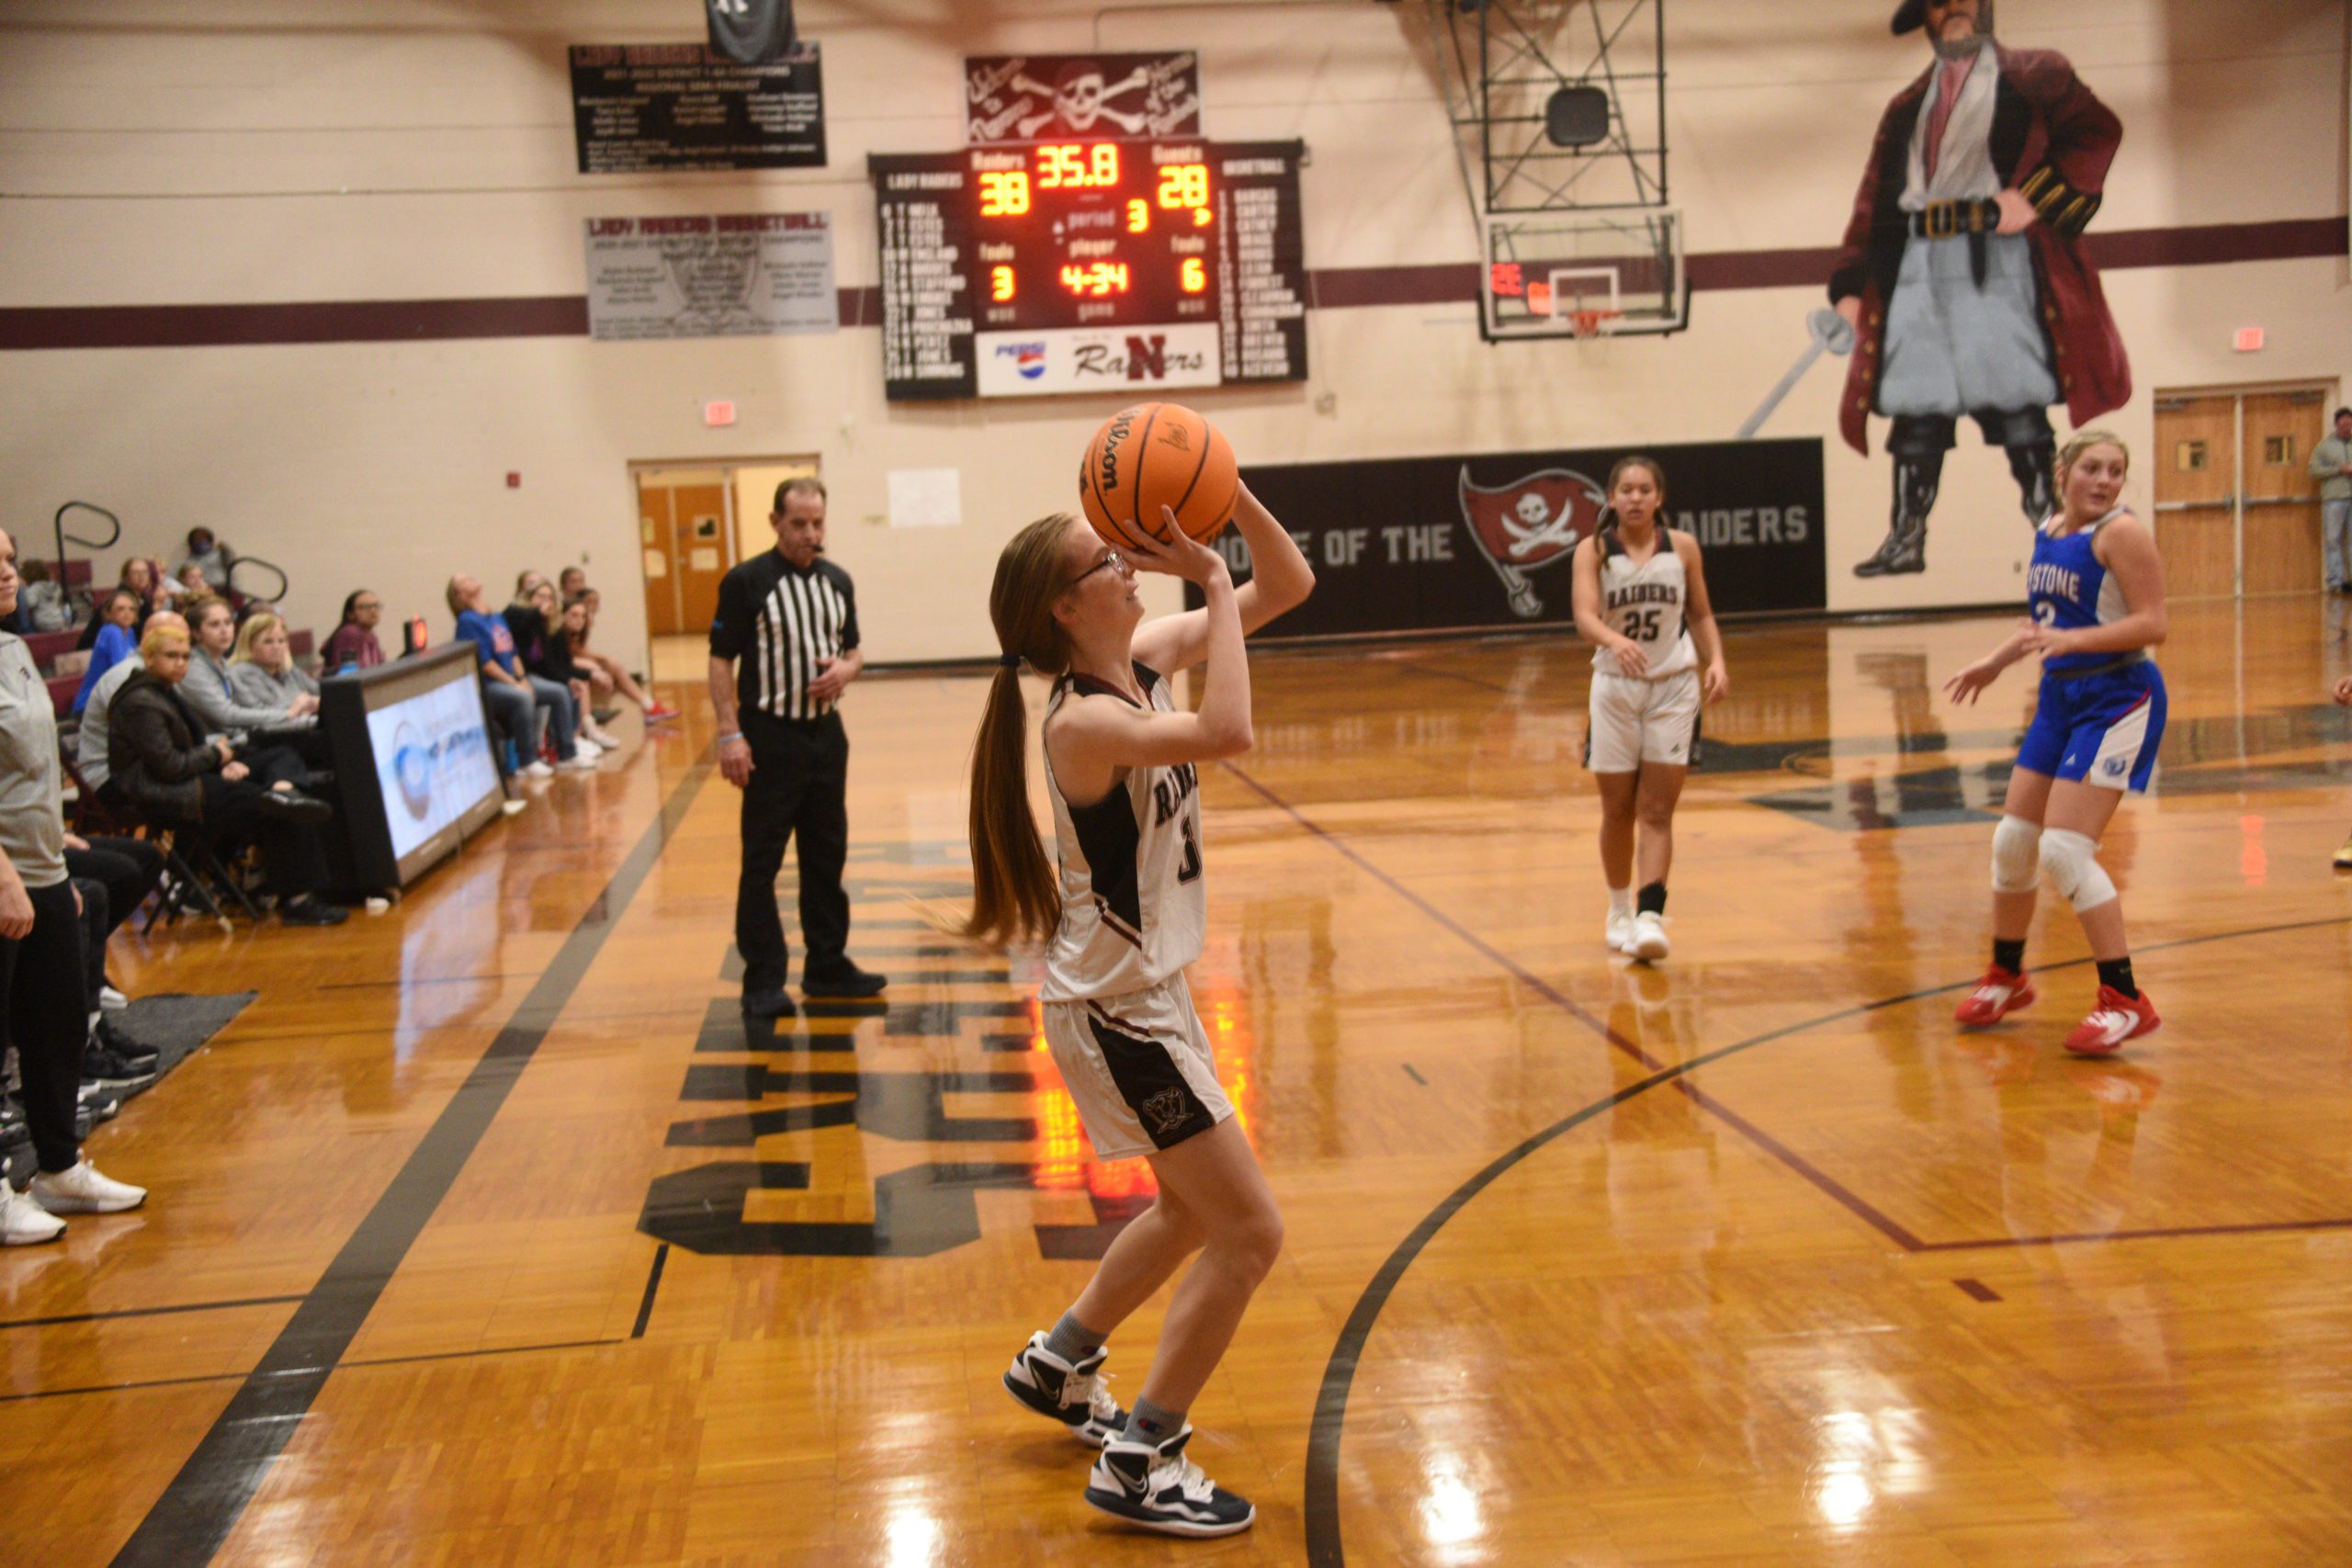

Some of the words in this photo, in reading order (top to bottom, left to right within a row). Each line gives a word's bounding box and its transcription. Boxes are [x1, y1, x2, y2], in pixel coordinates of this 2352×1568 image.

[1036, 143, 1118, 188] 35.8
[978, 171, 1031, 217] 38
[1158, 164, 1209, 209] 28
[1068, 209, 1115, 232] period
[1126, 197, 1149, 233] 3
[991, 265, 1015, 302] 3
[1182, 257, 1206, 294] 6
[996, 342, 1046, 356] PEPSI
[1324, 528, 1368, 567] OF
[1381, 524, 1454, 563] THE
[1677, 506, 1808, 546] AIDERS
[1608, 582, 1678, 610] RAIDERS
[1623, 610, 1662, 641] 25
